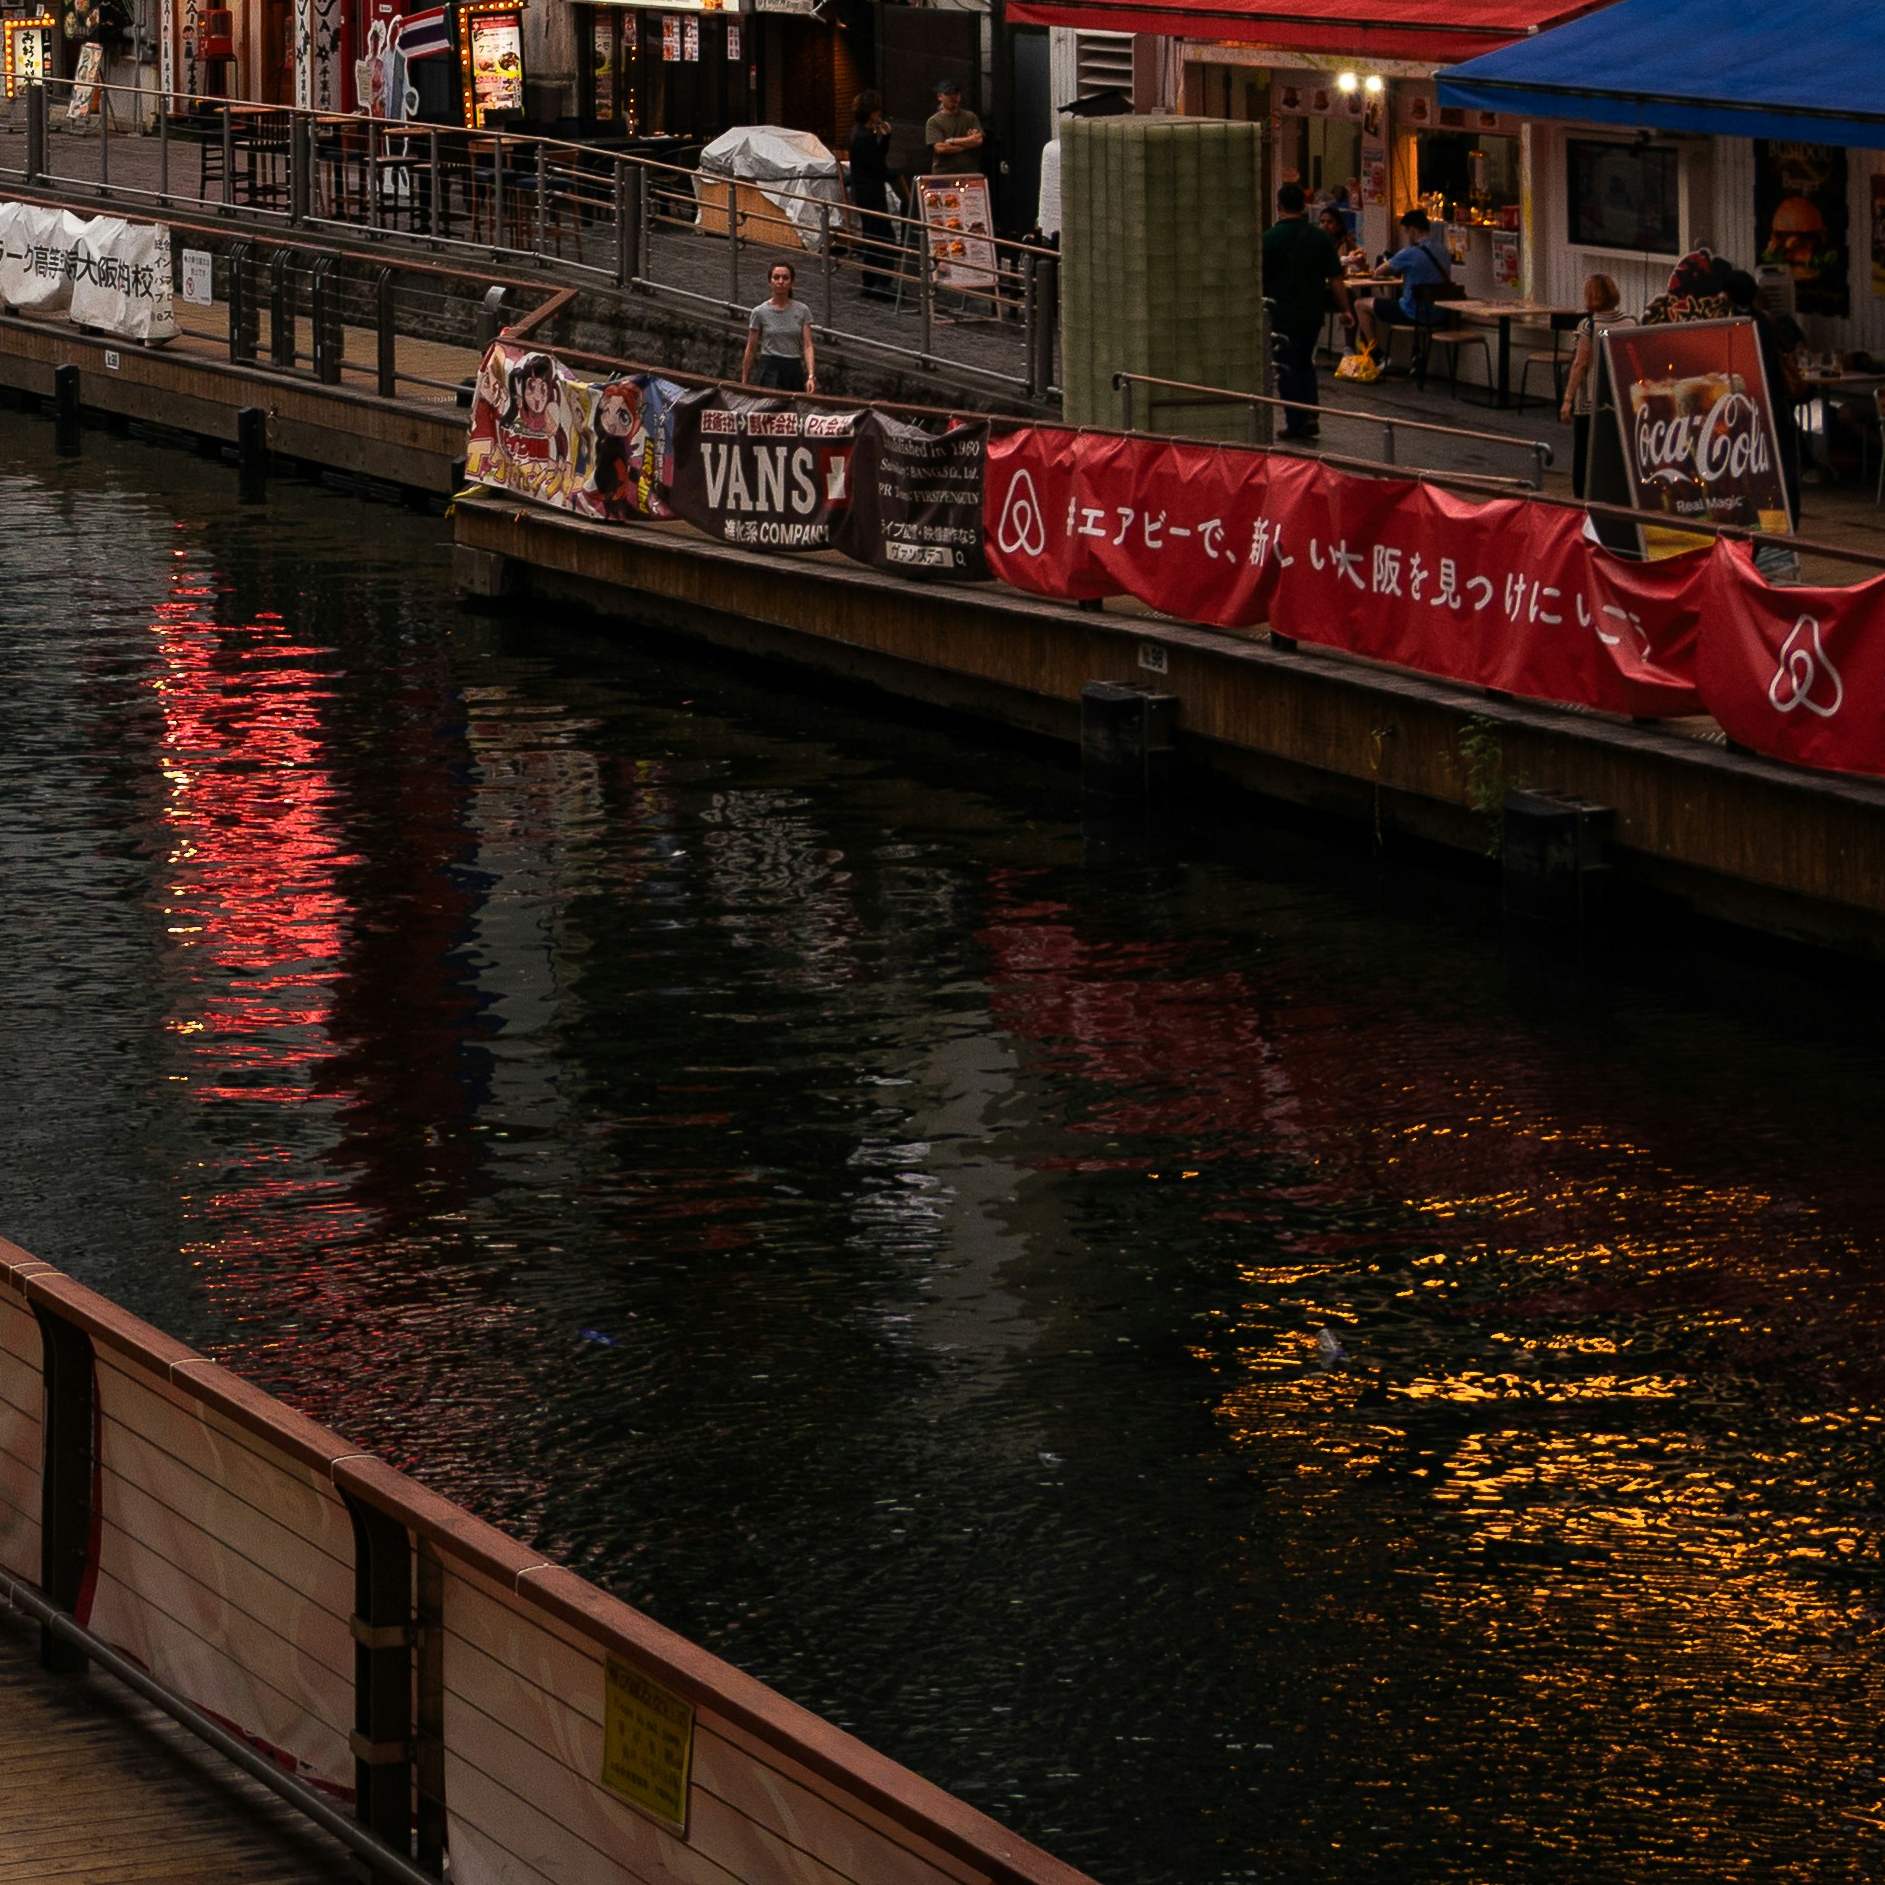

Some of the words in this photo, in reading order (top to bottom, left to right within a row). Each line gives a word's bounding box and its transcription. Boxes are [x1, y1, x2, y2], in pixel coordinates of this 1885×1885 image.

[319, 65, 332, 111] 手裏剣
[931, 441, 947, 457] in
[1634, 391, 1770, 485] Coca-Cola
[700, 442, 817, 515] VANS
[1676, 497, 1703, 513] Real
[1710, 495, 1746, 510] Magic
